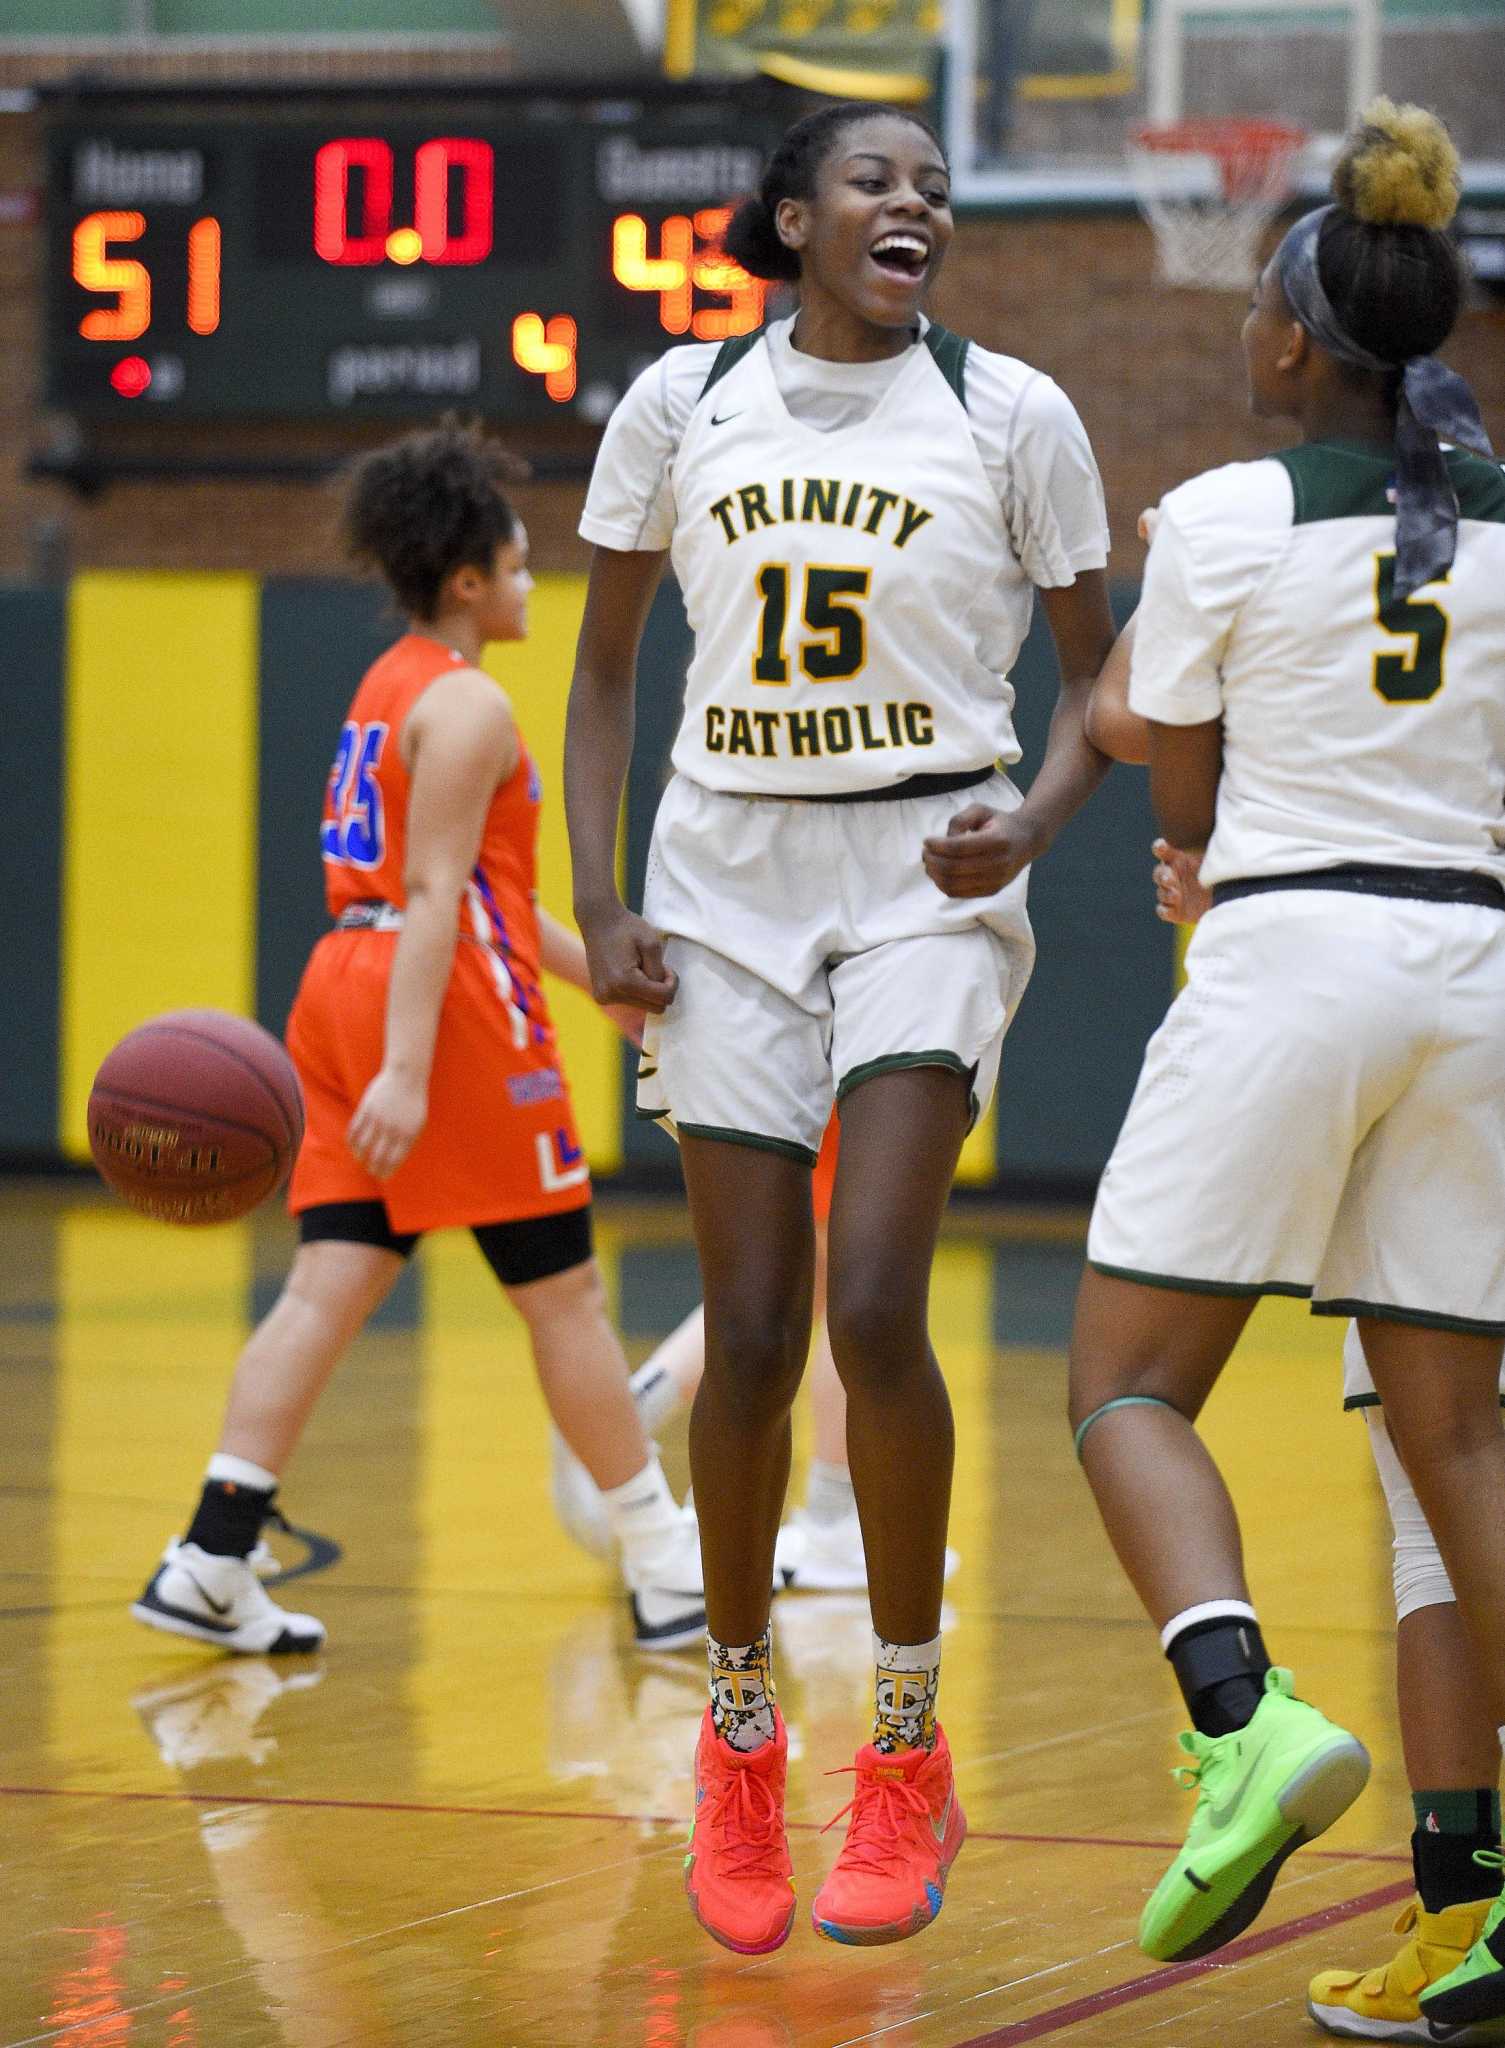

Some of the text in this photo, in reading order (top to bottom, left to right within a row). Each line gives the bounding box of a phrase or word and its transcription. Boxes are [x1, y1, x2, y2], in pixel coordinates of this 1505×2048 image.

[313, 136, 495, 267] 0.0
[72, 210, 222, 342] 51
[512, 313, 578, 403] 4
[709, 477, 935, 550] TRINITY
[752, 561, 873, 687] 15
[1371, 549, 1454, 706] 5
[705, 702, 935, 758] CATHOLIC
